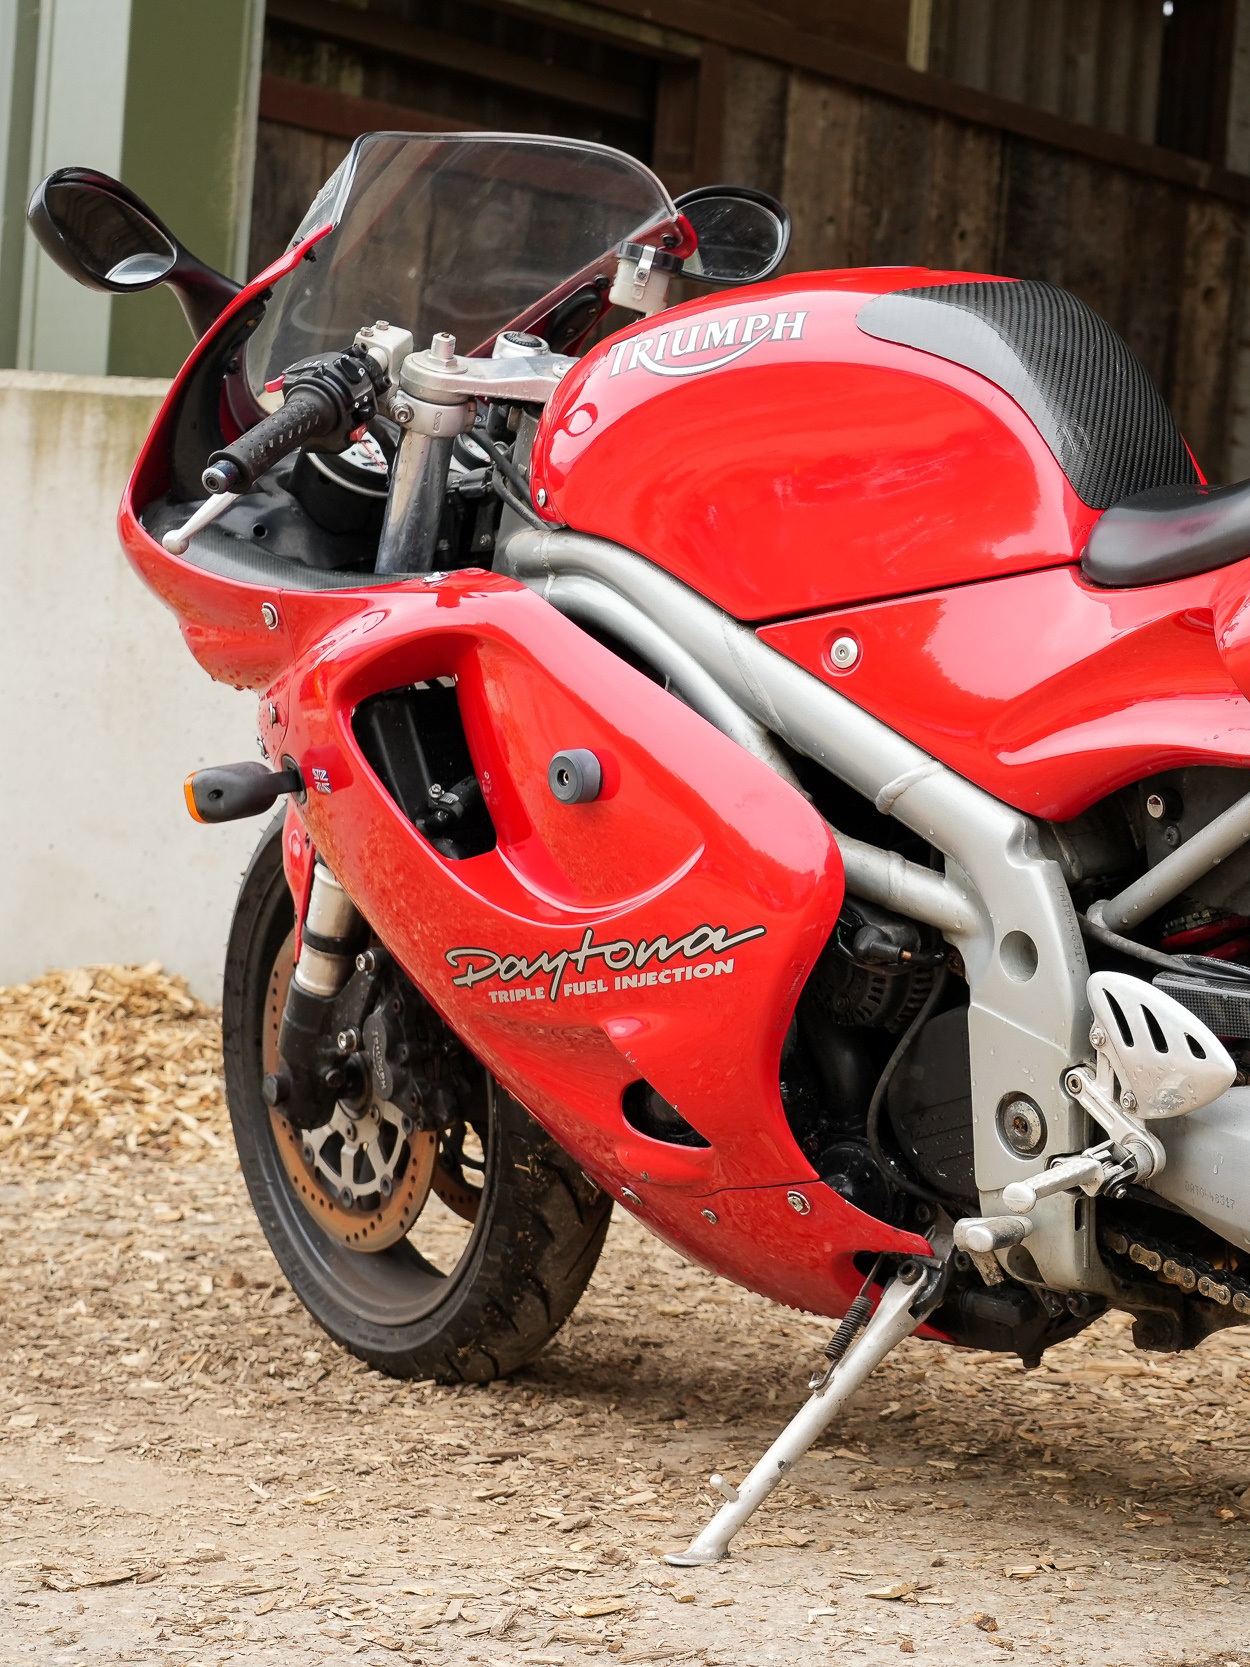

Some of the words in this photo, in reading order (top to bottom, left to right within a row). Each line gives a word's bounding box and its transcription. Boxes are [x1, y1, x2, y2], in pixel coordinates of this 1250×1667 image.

[608, 311, 809, 378] TRIUMPH
[444, 923, 767, 1002] Daytona
[488, 986, 546, 1004] TRIPLE
[563, 978, 609, 998] FUEL
[614, 958, 736, 991] INJECTION
